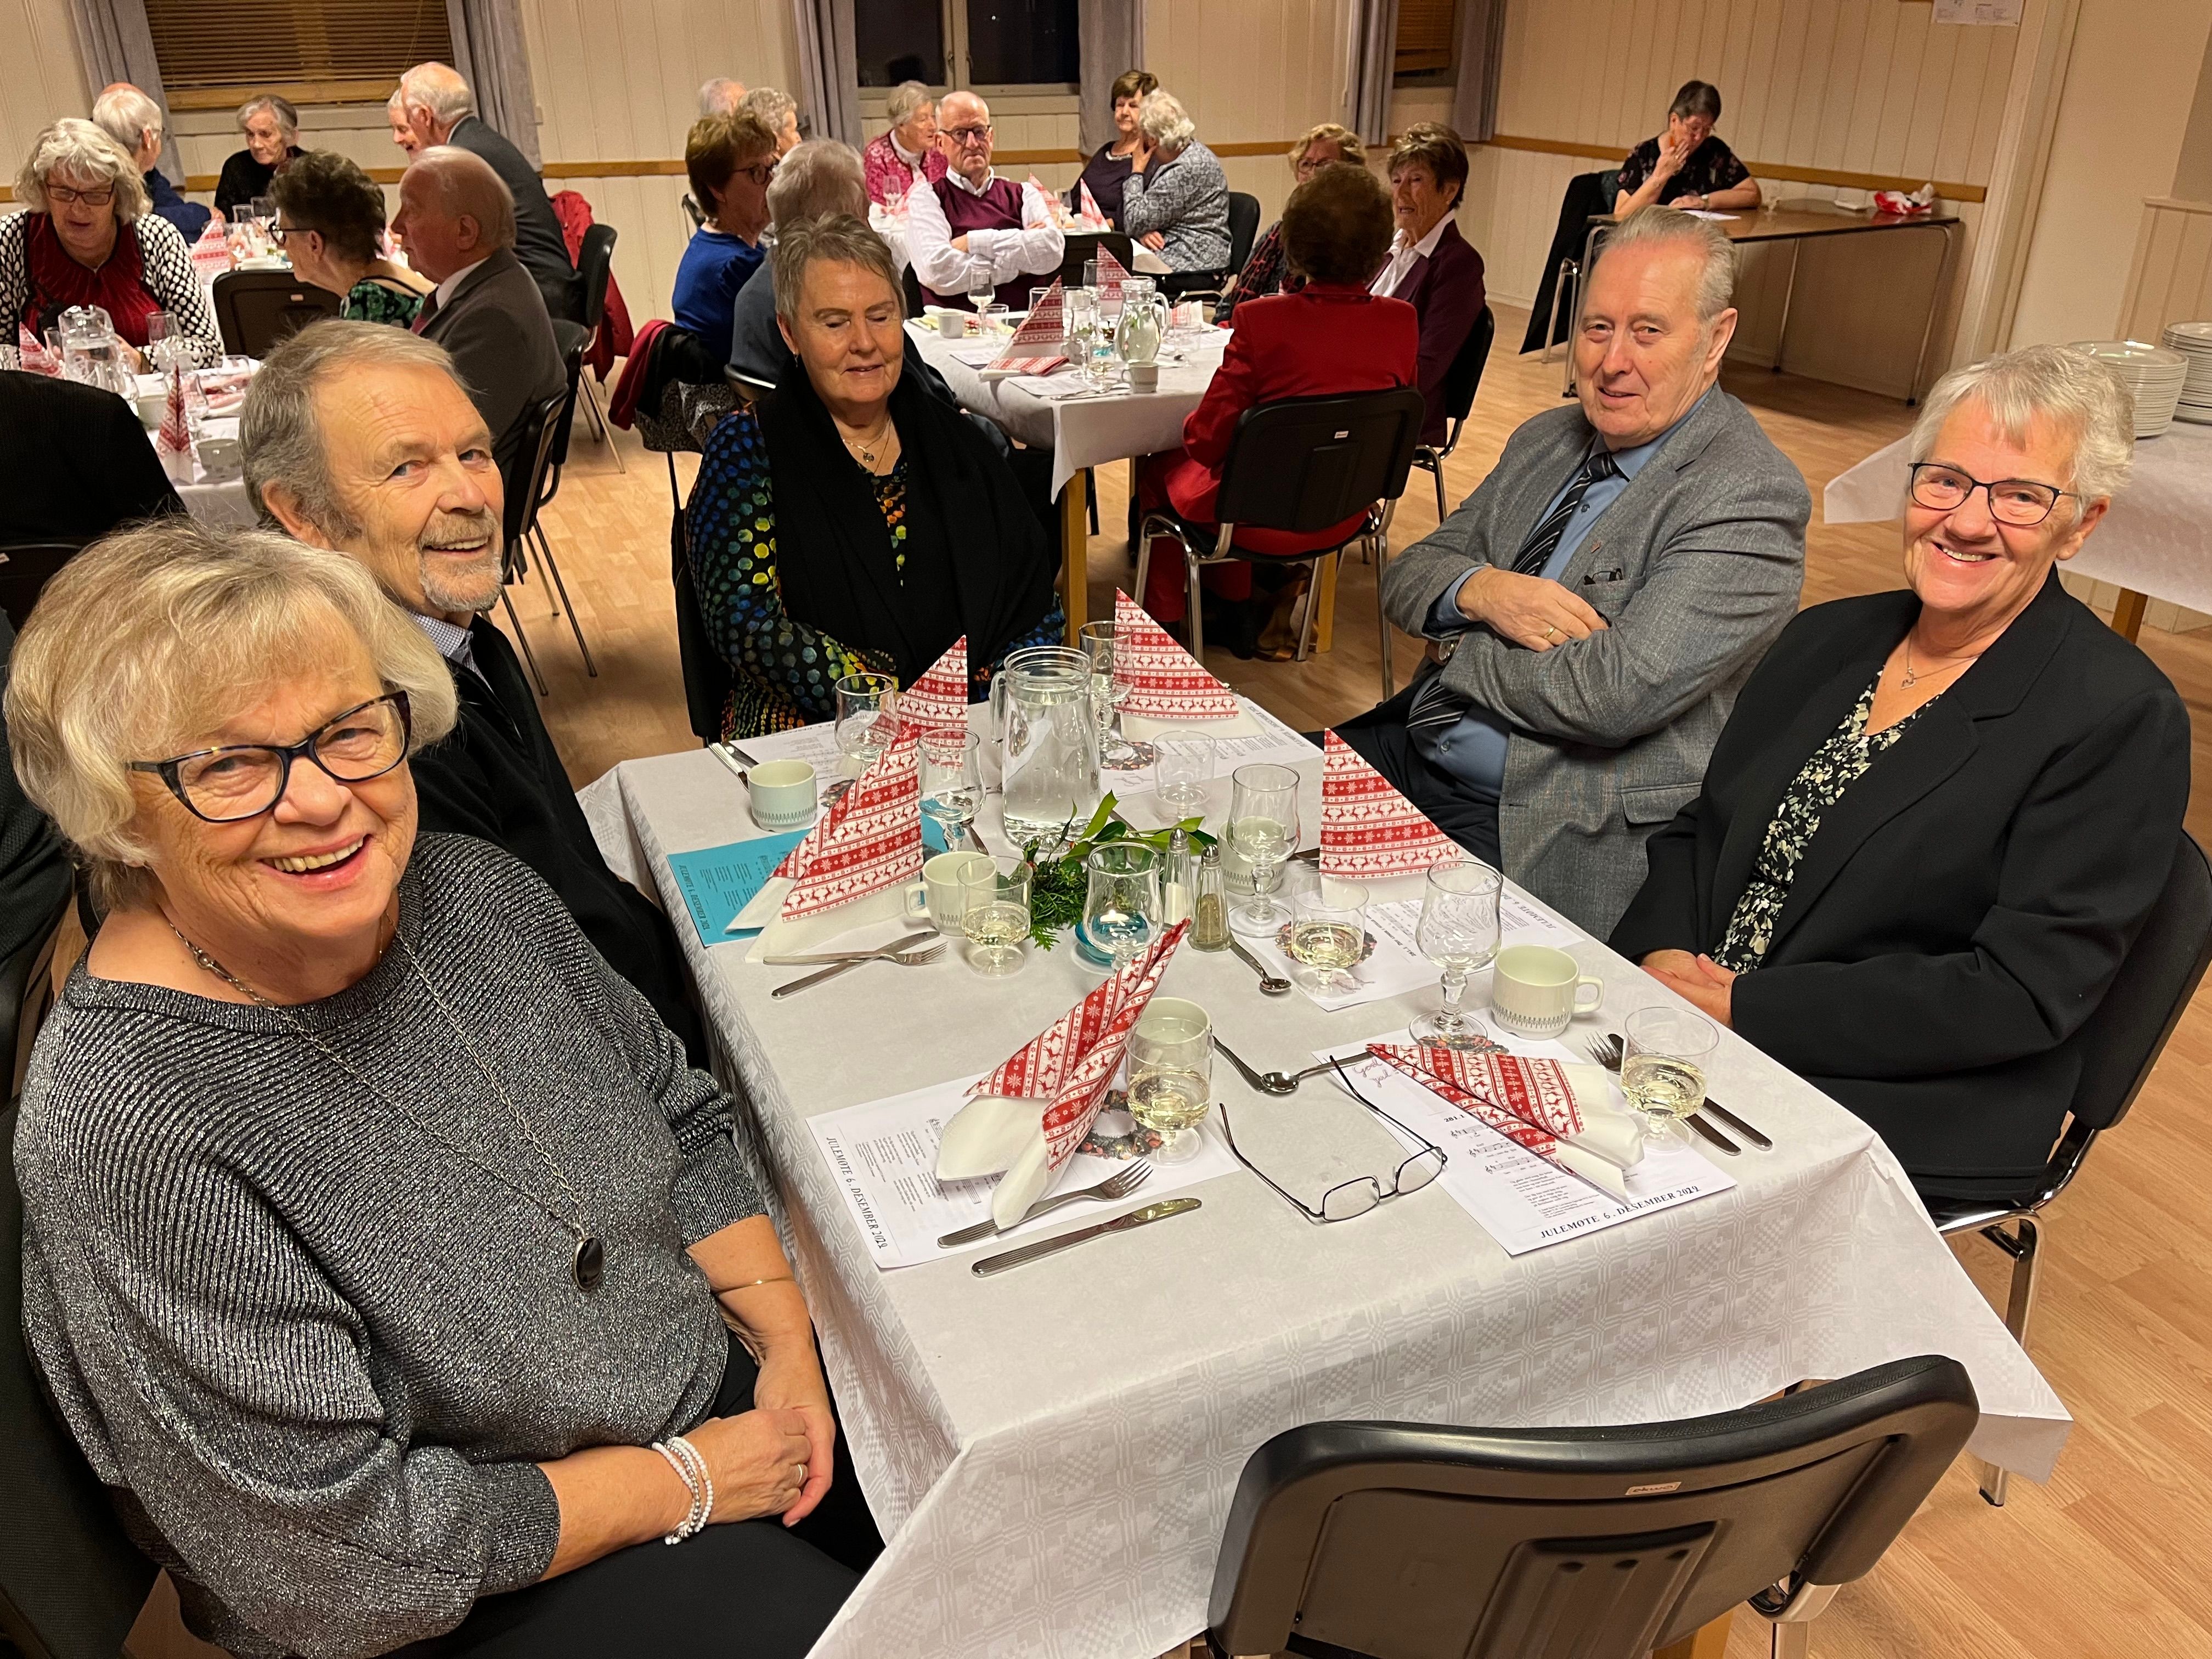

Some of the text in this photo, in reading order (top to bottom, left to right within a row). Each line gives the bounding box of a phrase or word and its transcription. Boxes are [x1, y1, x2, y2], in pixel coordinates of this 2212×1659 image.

[850, 1188, 878, 1229] DESEMBER
[1541, 1216, 1600, 1238] JULEMØTE
[1616, 1193, 1676, 1215] DESEMBER
